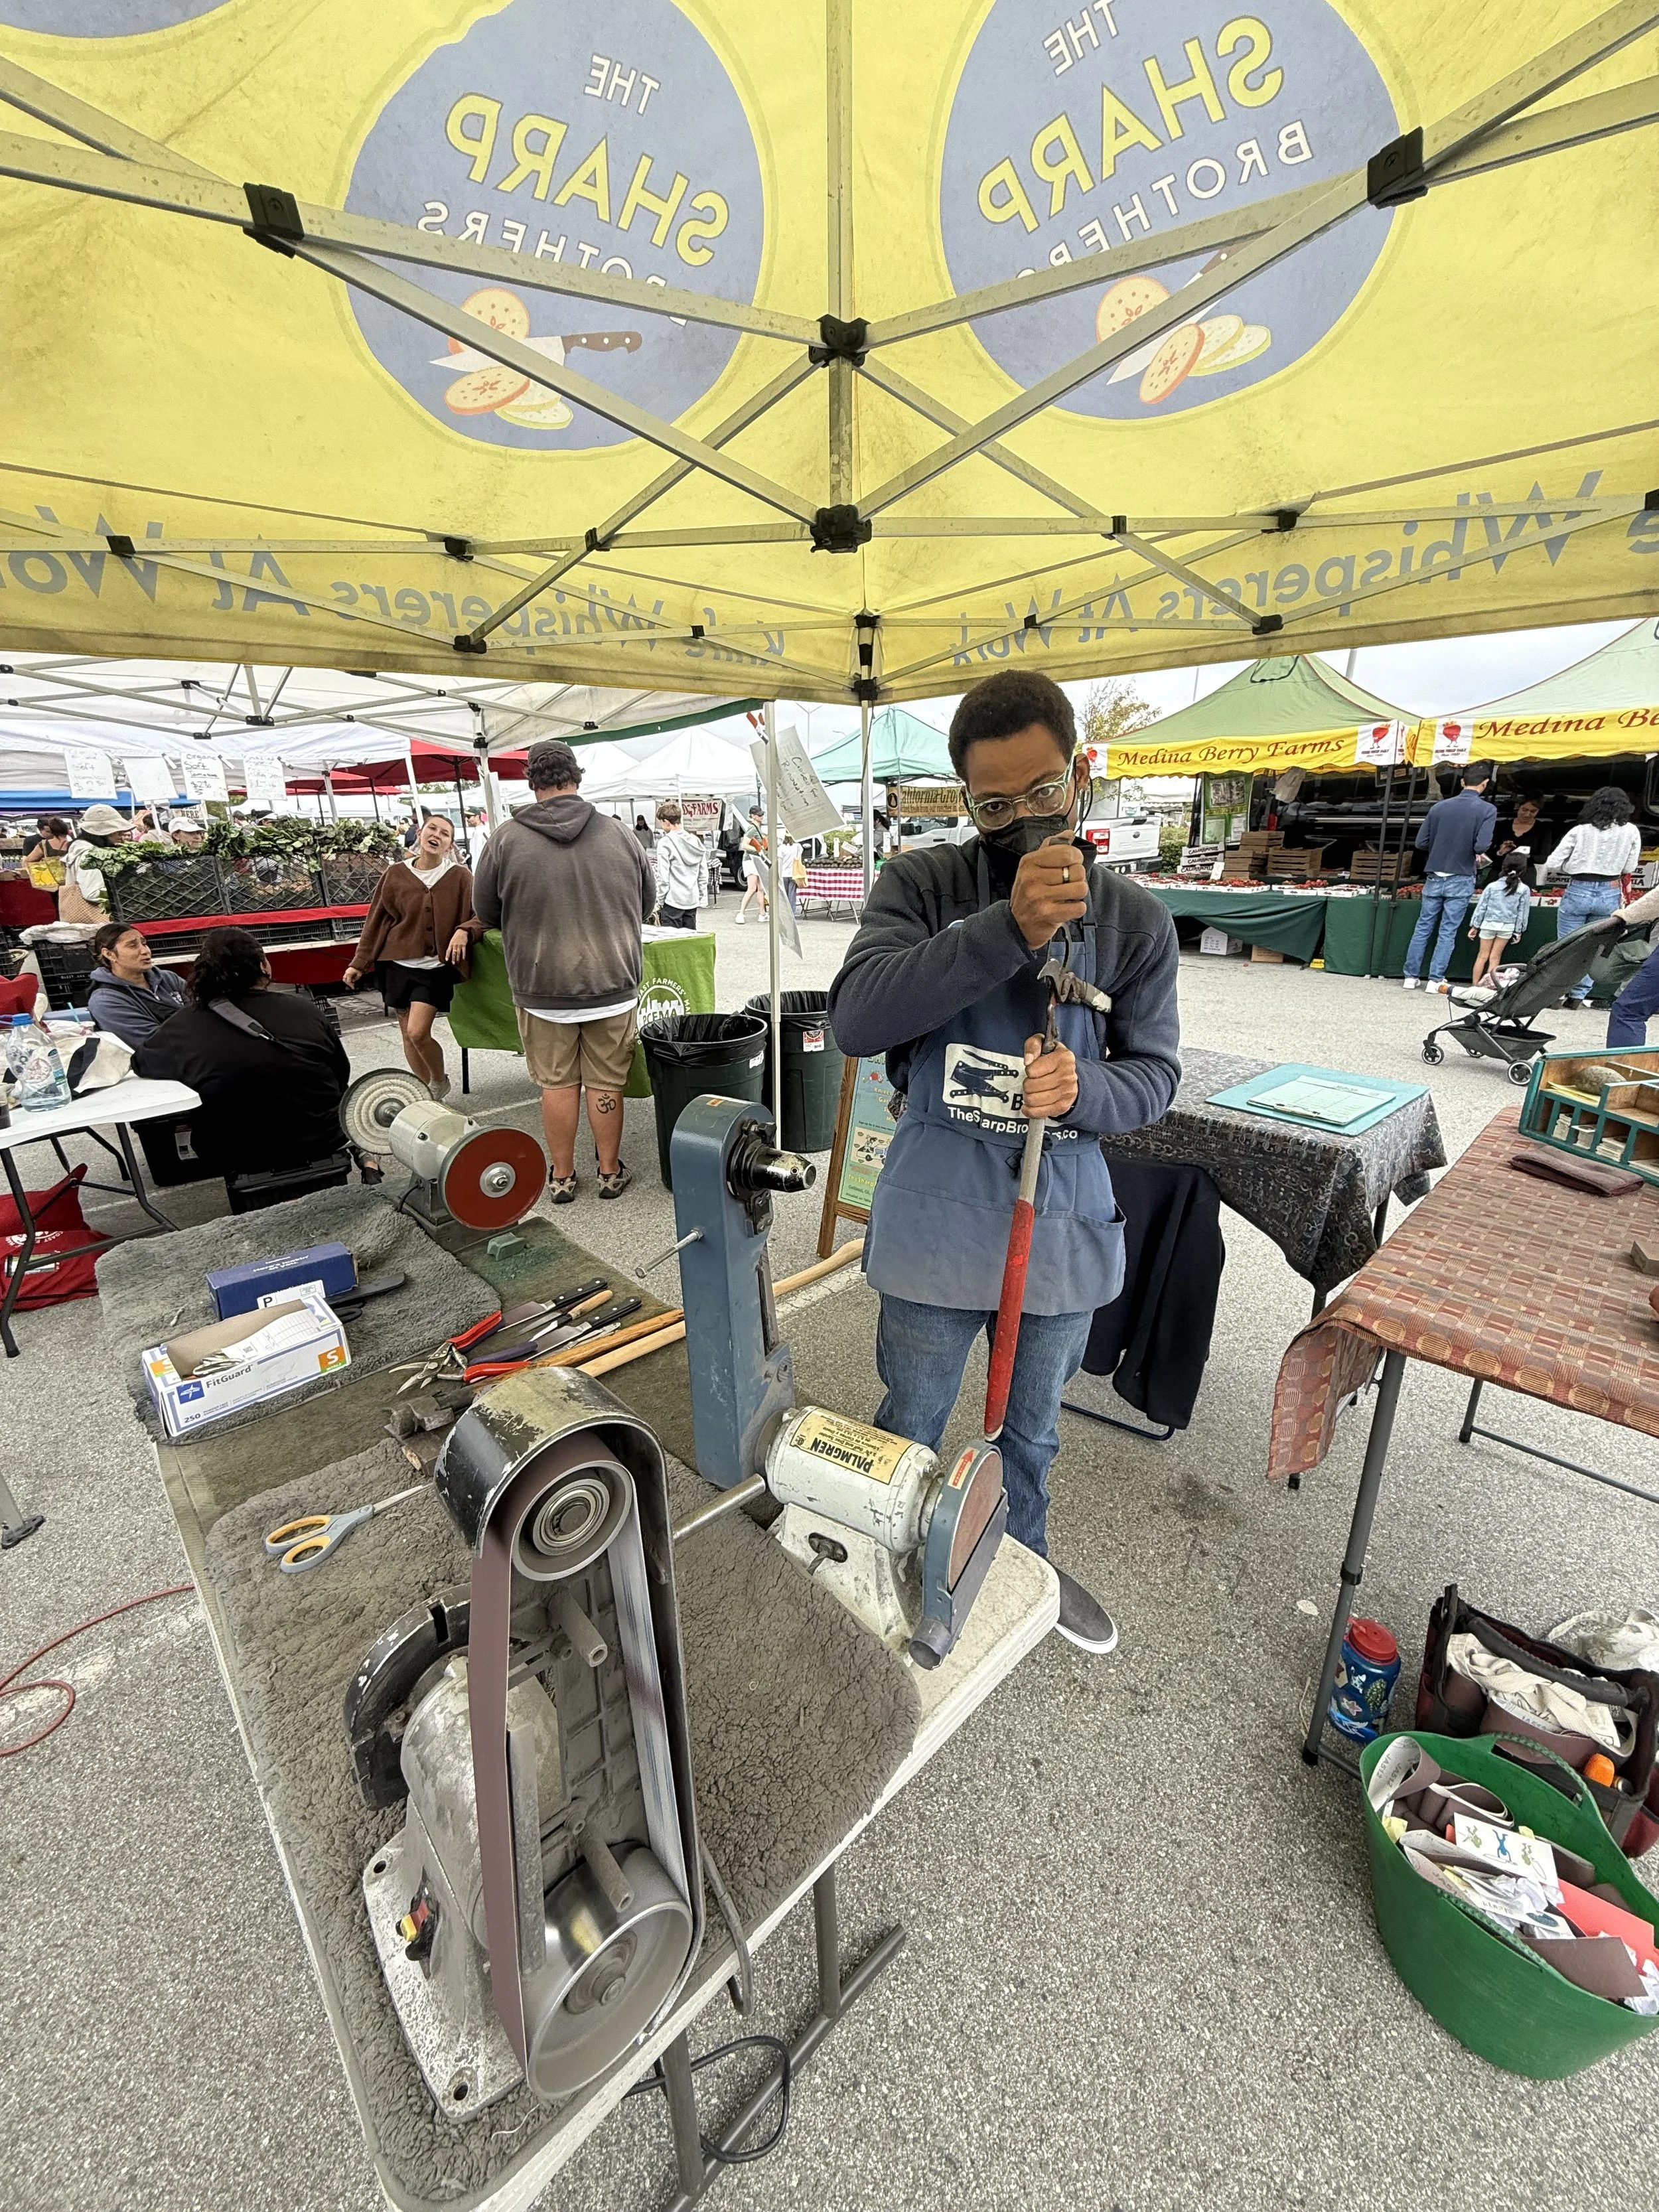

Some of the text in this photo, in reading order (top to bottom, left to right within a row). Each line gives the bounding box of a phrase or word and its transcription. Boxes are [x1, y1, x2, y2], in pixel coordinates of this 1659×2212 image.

[1476, 715, 1606, 739] Medina
[1117, 749, 1192, 766] Medina
[1198, 745, 1260, 764] Berry
[1267, 739, 1344, 757] Farms
[326, 1349, 339, 1365] S
[184, 1413, 201, 1424] 250
[810, 1437, 875, 1473] PALMGREN
